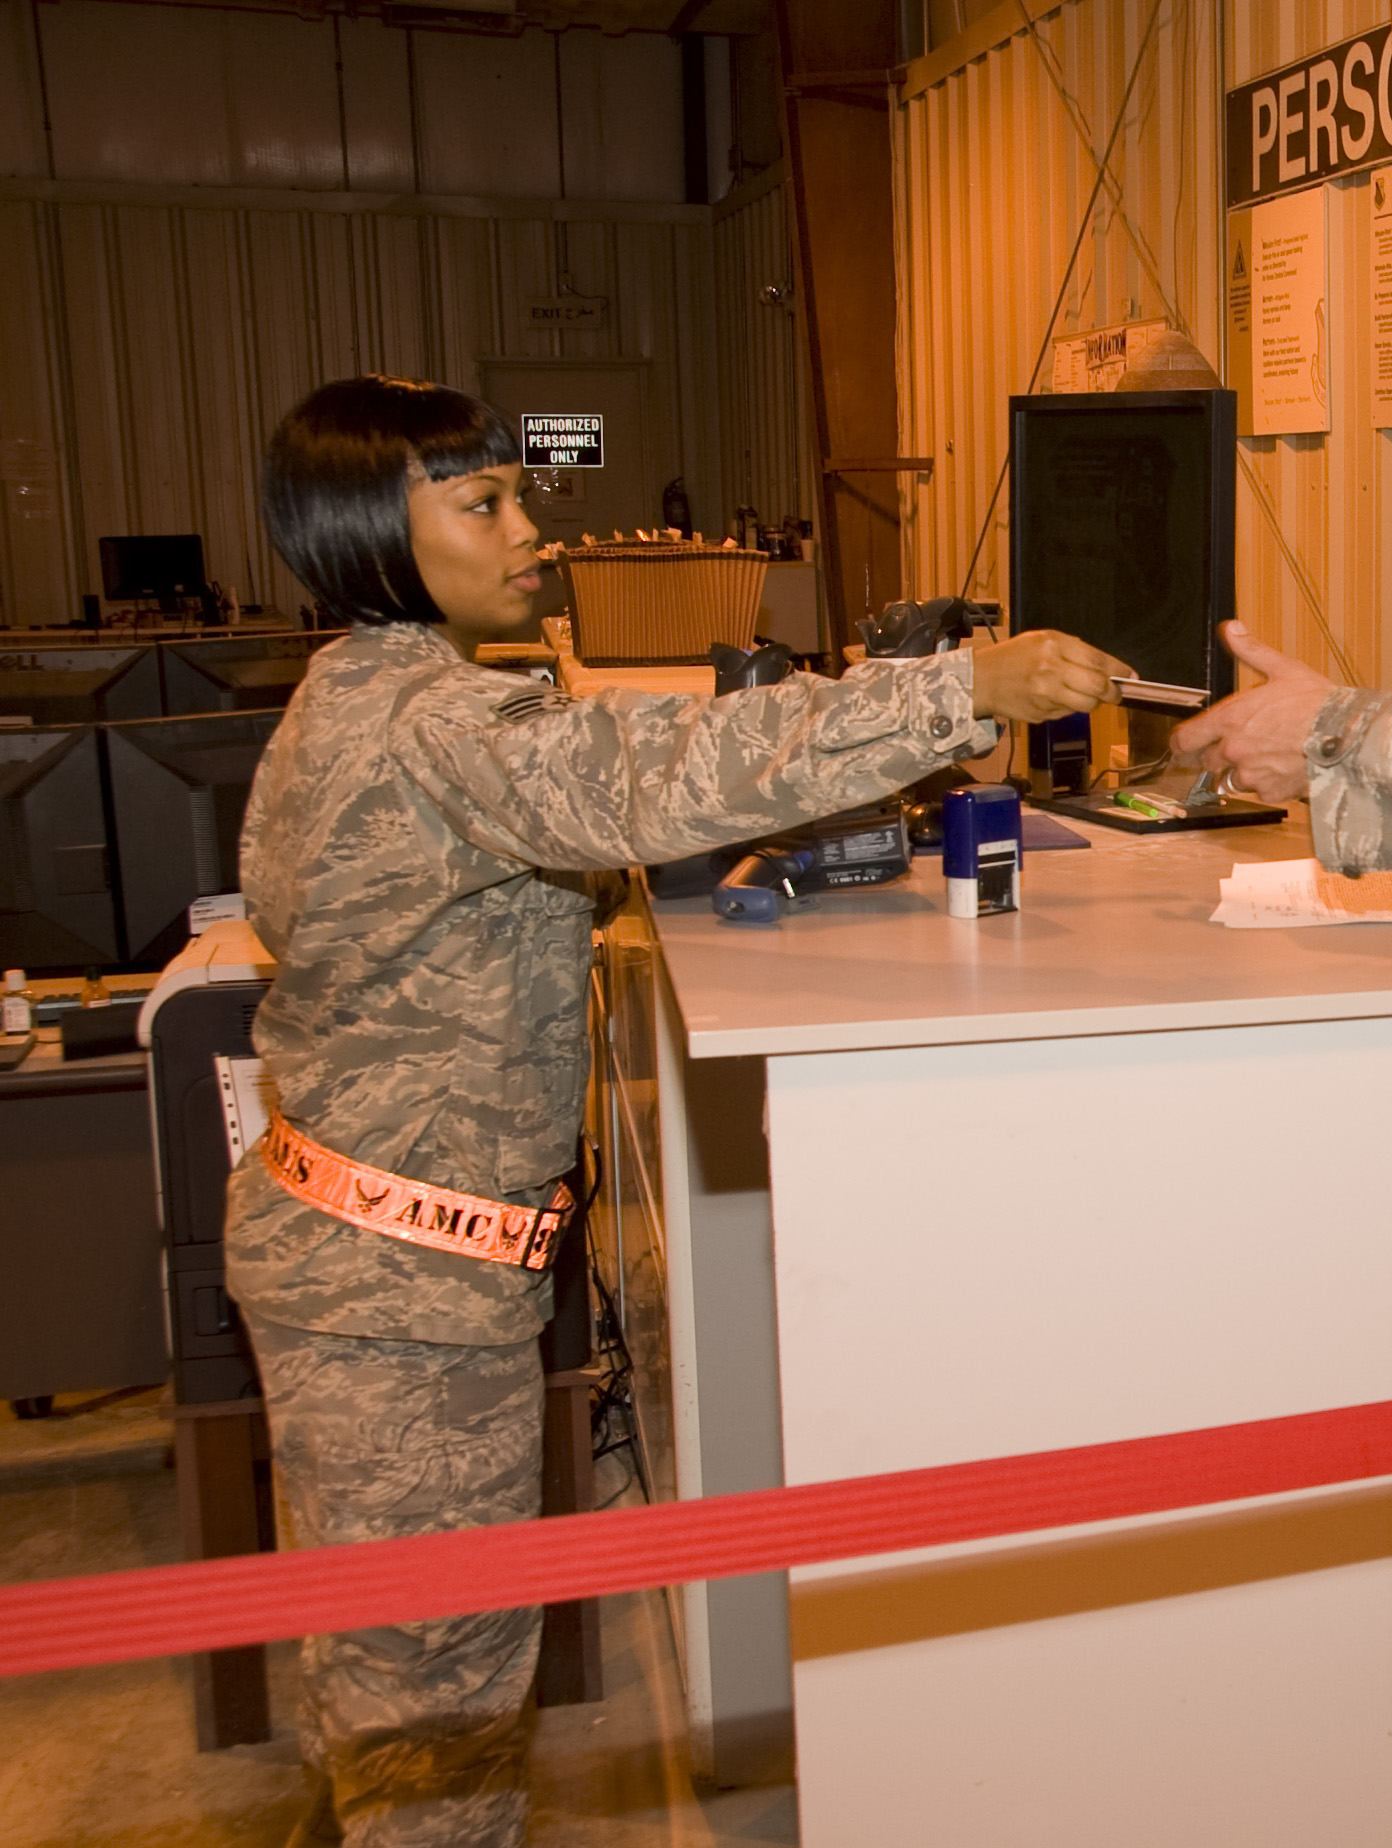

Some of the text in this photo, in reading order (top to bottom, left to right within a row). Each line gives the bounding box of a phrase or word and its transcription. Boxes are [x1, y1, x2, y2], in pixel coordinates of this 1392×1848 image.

[532, 308, 561, 319] EXIT
[526, 418, 600, 432] AUTHORIZED
[528, 434, 599, 448] PERSONNEL
[550, 451, 579, 464] ONLY
[397, 1197, 493, 1243] AMC
